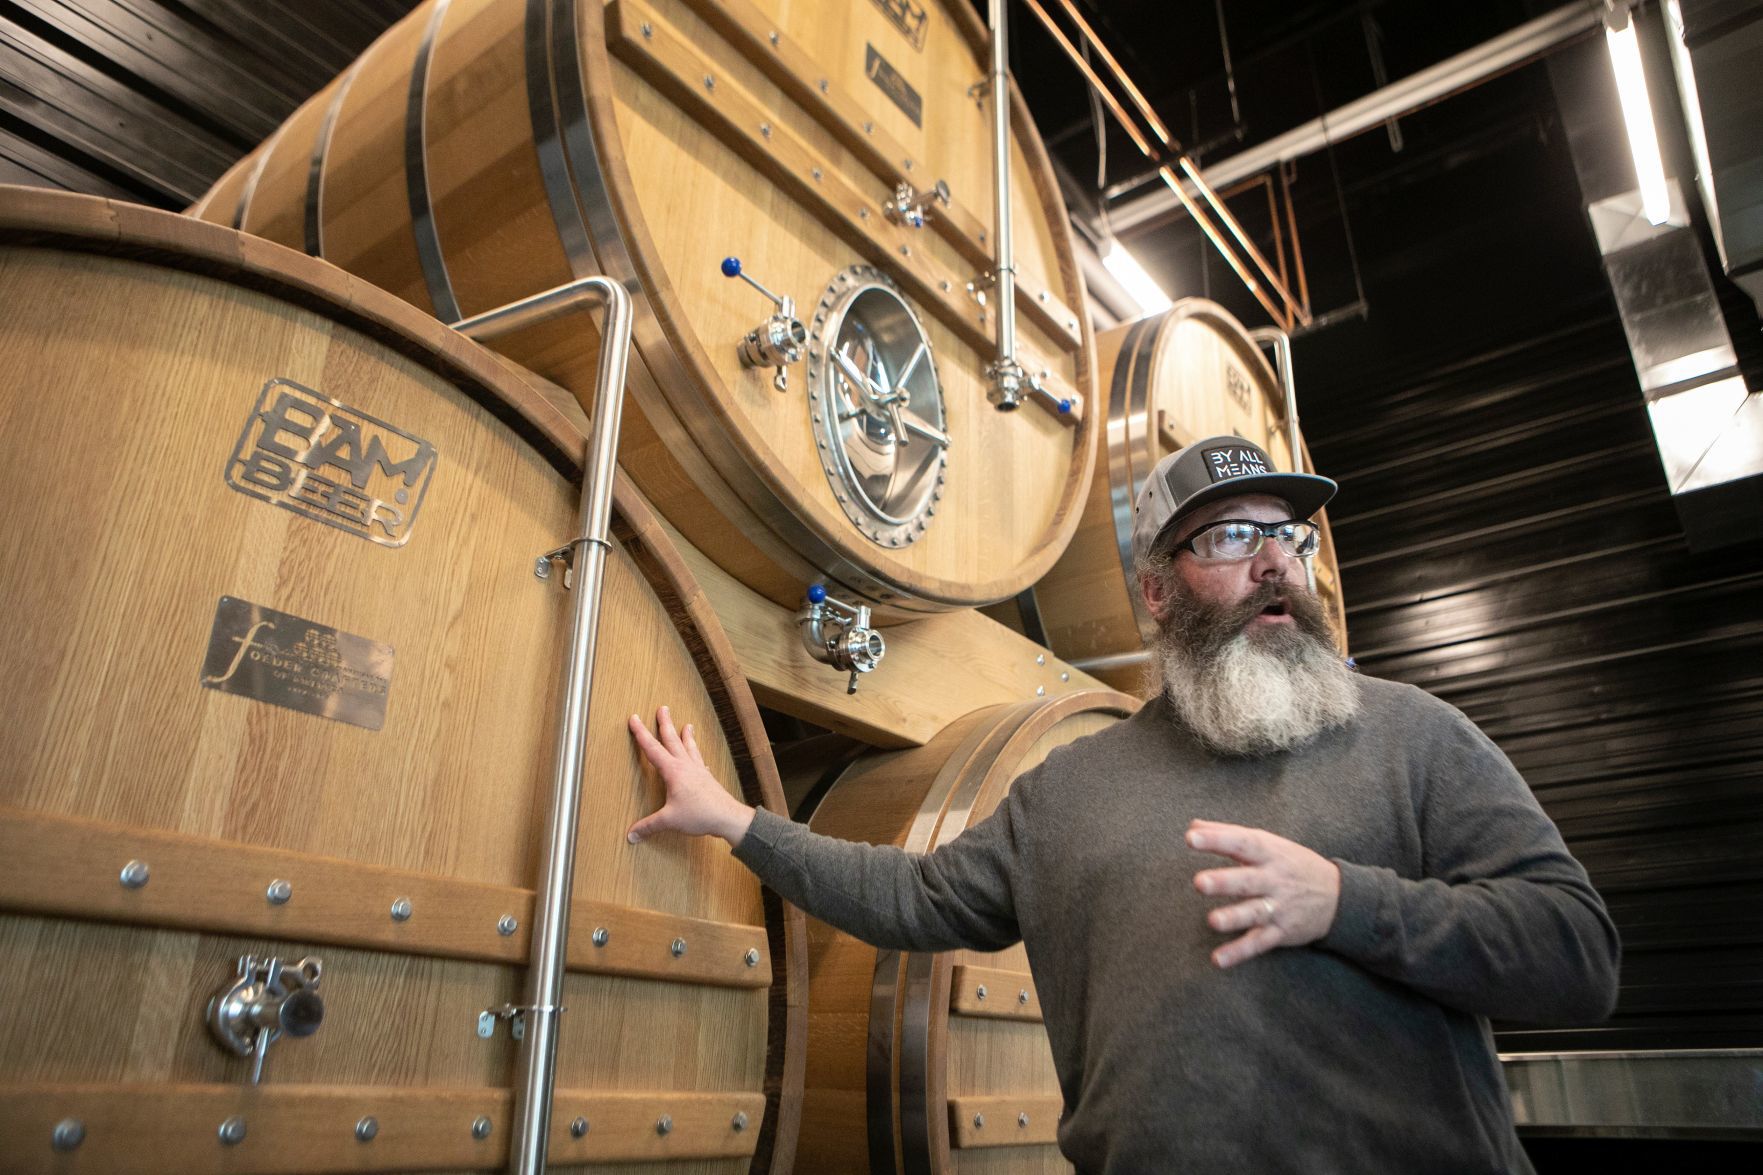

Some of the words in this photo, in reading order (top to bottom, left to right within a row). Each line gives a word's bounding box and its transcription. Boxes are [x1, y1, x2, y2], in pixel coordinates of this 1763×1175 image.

[1211, 450, 1233, 464] BY
[1240, 450, 1264, 464] ALL
[1216, 463, 1268, 478] MEANS
[241, 451, 403, 537] BEER
